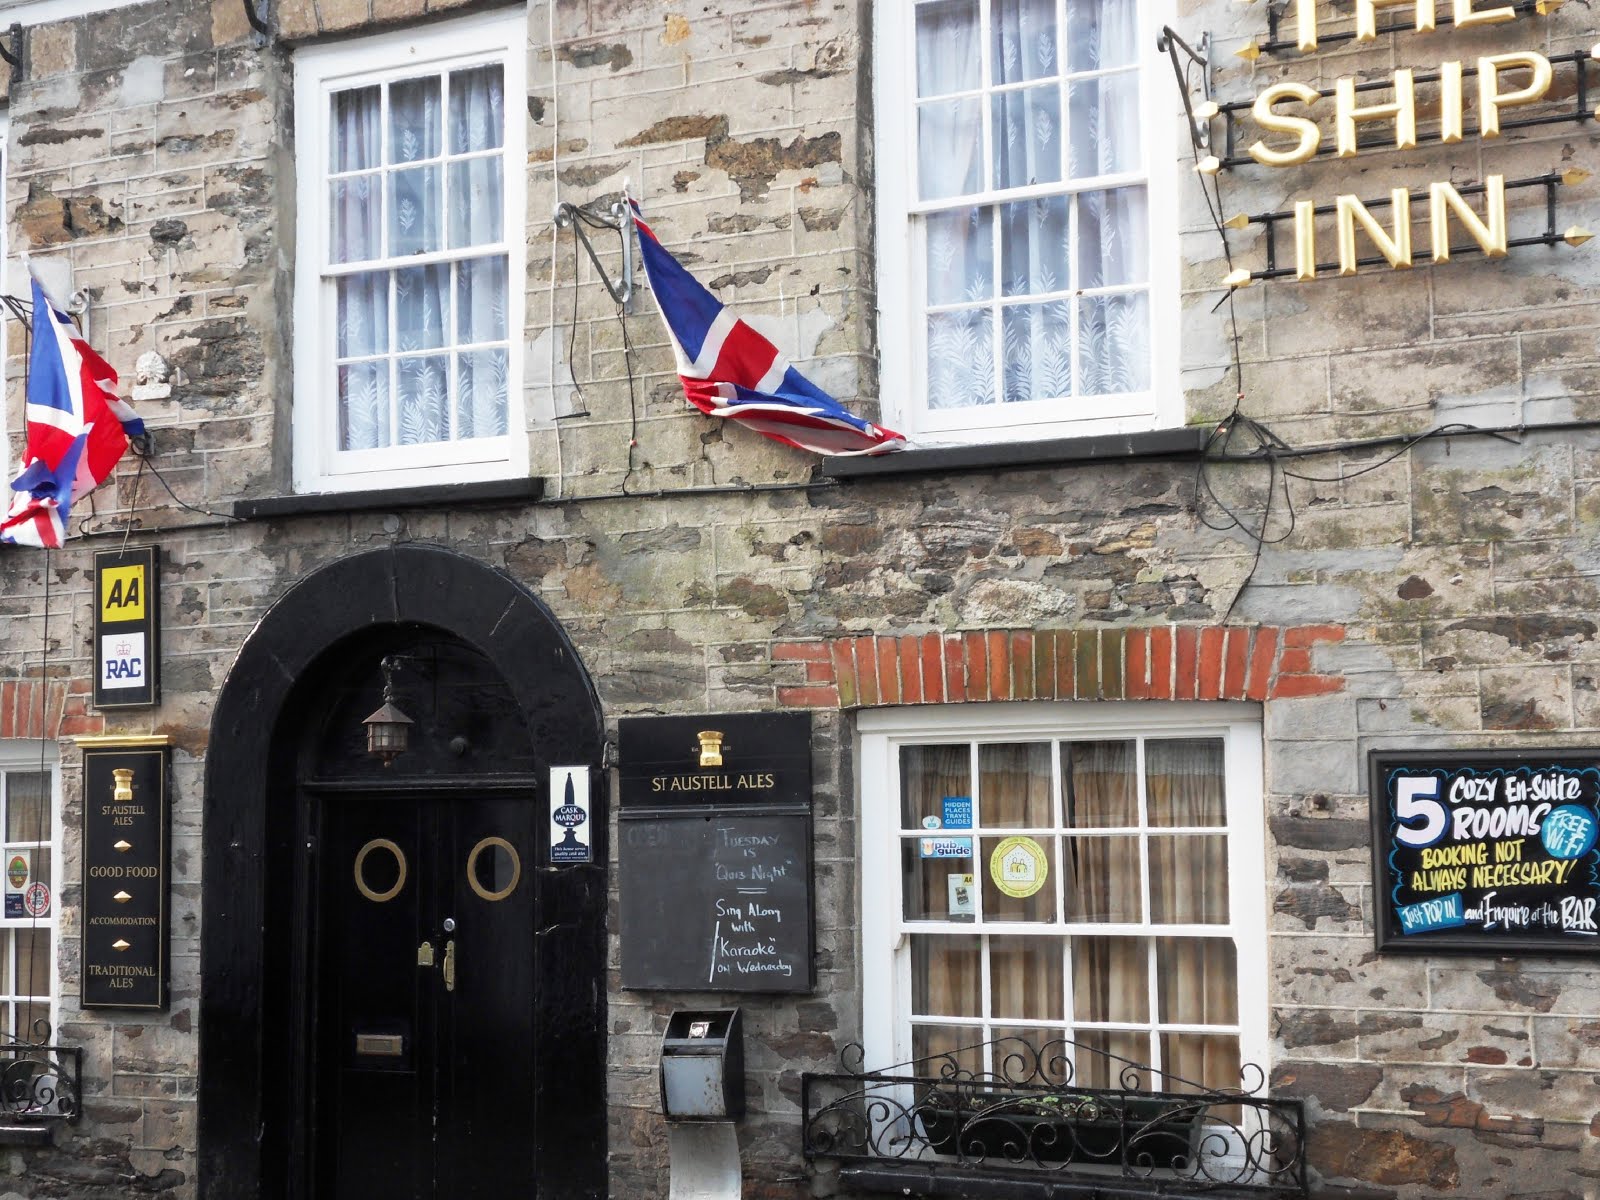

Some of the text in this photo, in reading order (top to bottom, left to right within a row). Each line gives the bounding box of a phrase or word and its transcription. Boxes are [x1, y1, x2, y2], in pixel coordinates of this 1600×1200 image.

[1248, 51, 1553, 168] SHIP
[1295, 174, 1509, 281] INN
[105, 577, 139, 609] AA
[106, 657, 141, 679] RAC
[670, 775, 732, 791] AUSTELL
[737, 774, 774, 789] ALES
[112, 805, 145, 815] AUSTELL
[555, 813, 585, 822] MARQUE
[560, 806, 578, 814] CASK
[1396, 777, 1447, 845] 5
[113, 816, 133, 826] ALES
[1453, 803, 1552, 840] ROOMS
[1548, 809, 1591, 834] FREE
[934, 840, 957, 850] pub
[937, 847, 970, 856] guide
[1421, 839, 1525, 870] BOOKING NOT
[90, 866, 158, 878] GOOD FOOD
[1412, 858, 1578, 892] ALWAYS NECESSARY!
[716, 899, 742, 920] Sing
[1421, 901, 1443, 925] POP
[1464, 901, 1484, 921] and
[1483, 891, 1530, 929] Enquire
[1560, 895, 1598, 930] BAR
[89, 916, 157, 926] ACCOMMODATION
[88, 965, 156, 977] TRADITIONAL
[737, 959, 792, 976] Wednesday
[108, 977, 134, 989] ALES
